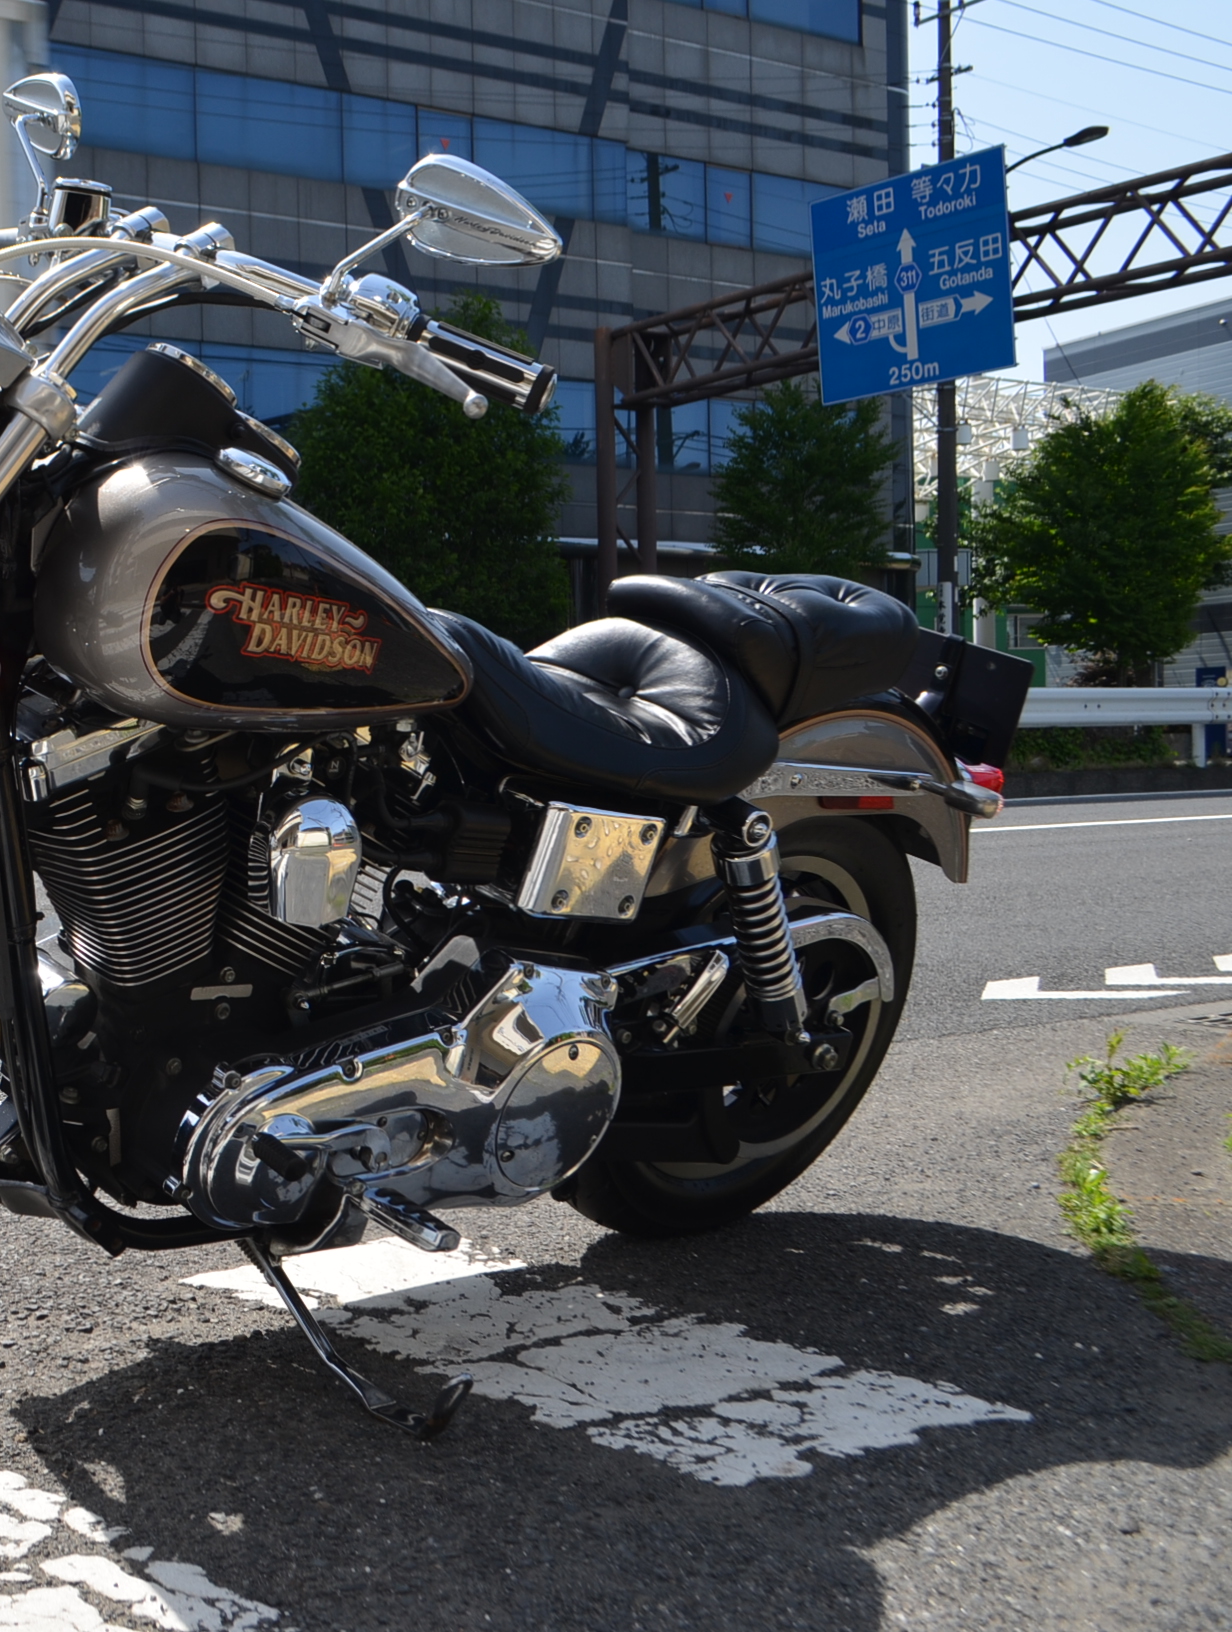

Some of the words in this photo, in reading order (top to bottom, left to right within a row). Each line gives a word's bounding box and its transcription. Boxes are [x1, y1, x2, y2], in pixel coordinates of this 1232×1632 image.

[911, 163, 981, 204] 等々力
[846, 187, 894, 224] 瀬田
[919, 192, 976, 220] Todoroki
[857, 219, 886, 239] Seta
[928, 233, 1002, 276] 五反田
[821, 263, 888, 304] 丸子橋
[900, 270, 916, 287] 311
[939, 267, 993, 290] Gotanda
[823, 291, 888, 319] Marukobashi
[921, 302, 950, 323] 街道
[855, 320, 866, 339] 2
[872, 312, 901, 333] 中原
[889, 361, 939, 385] 250m
[246, 622, 379, 668] DAVIDSON
